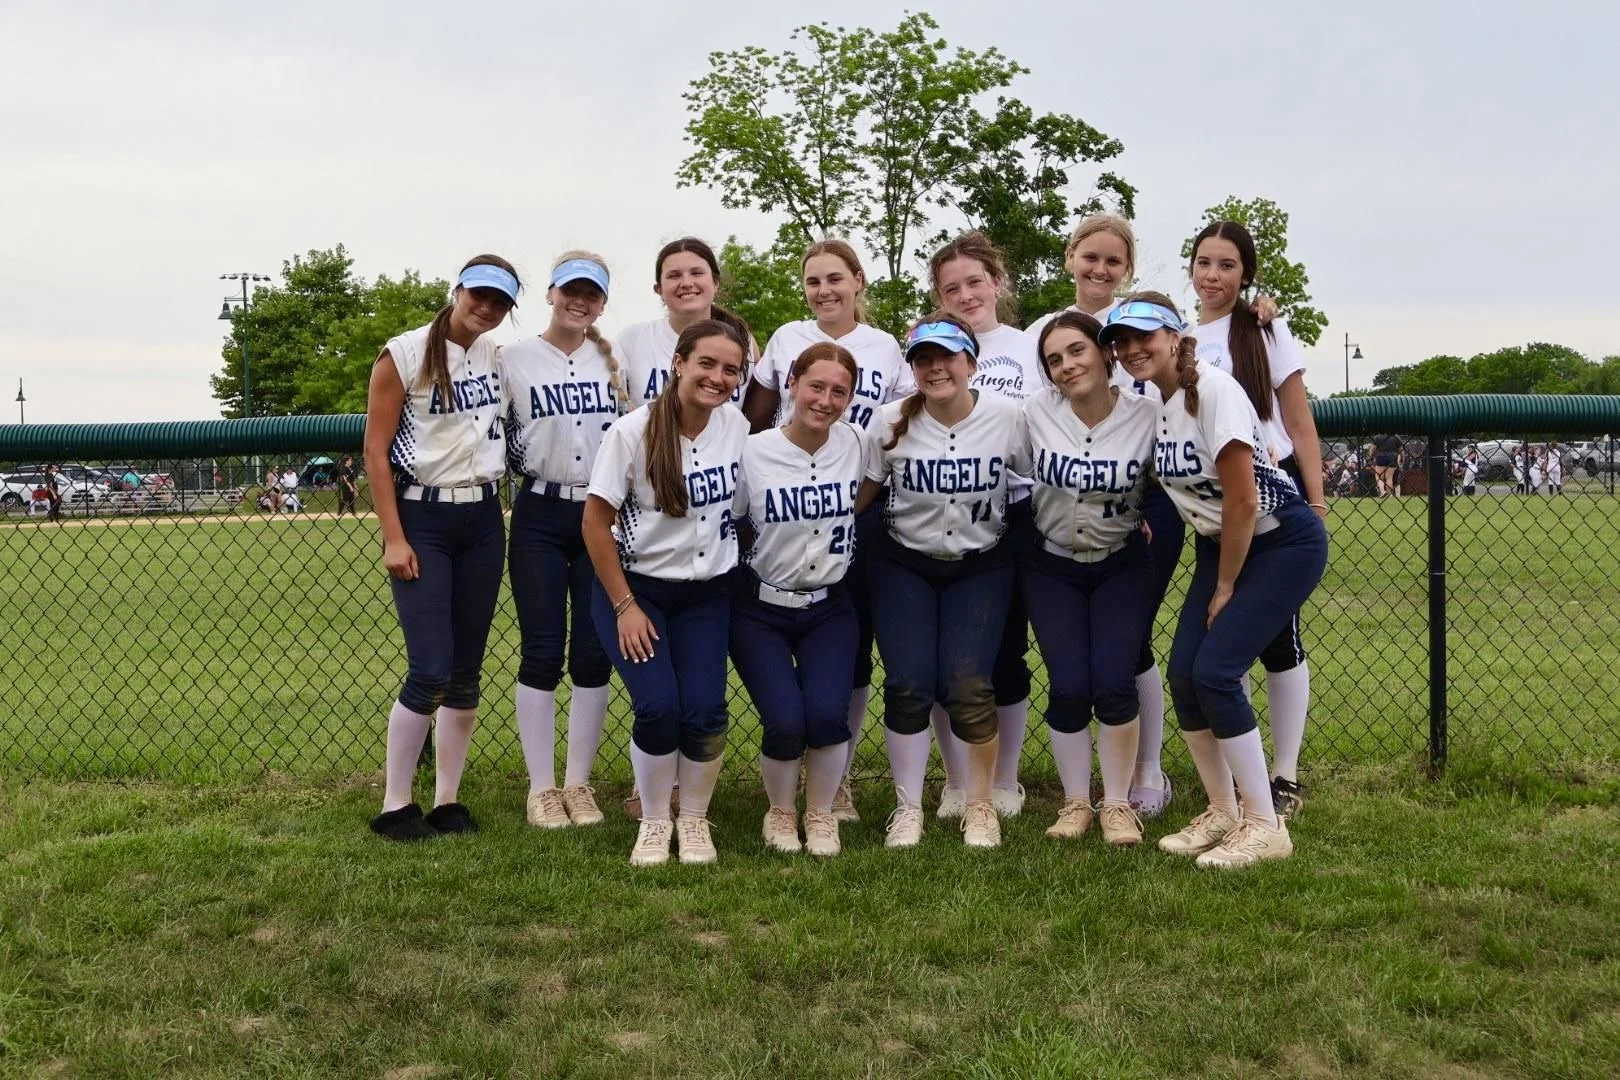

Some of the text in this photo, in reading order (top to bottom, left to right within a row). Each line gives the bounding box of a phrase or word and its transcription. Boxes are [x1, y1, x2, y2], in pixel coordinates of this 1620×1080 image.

[530, 382, 616, 420] ANGELS
[972, 374, 1023, 391] Angels
[902, 457, 1002, 494] ANGELS
[1037, 448, 1139, 494] ANGELS
[1156, 438, 1202, 477] GELS
[683, 462, 738, 508] GEL
